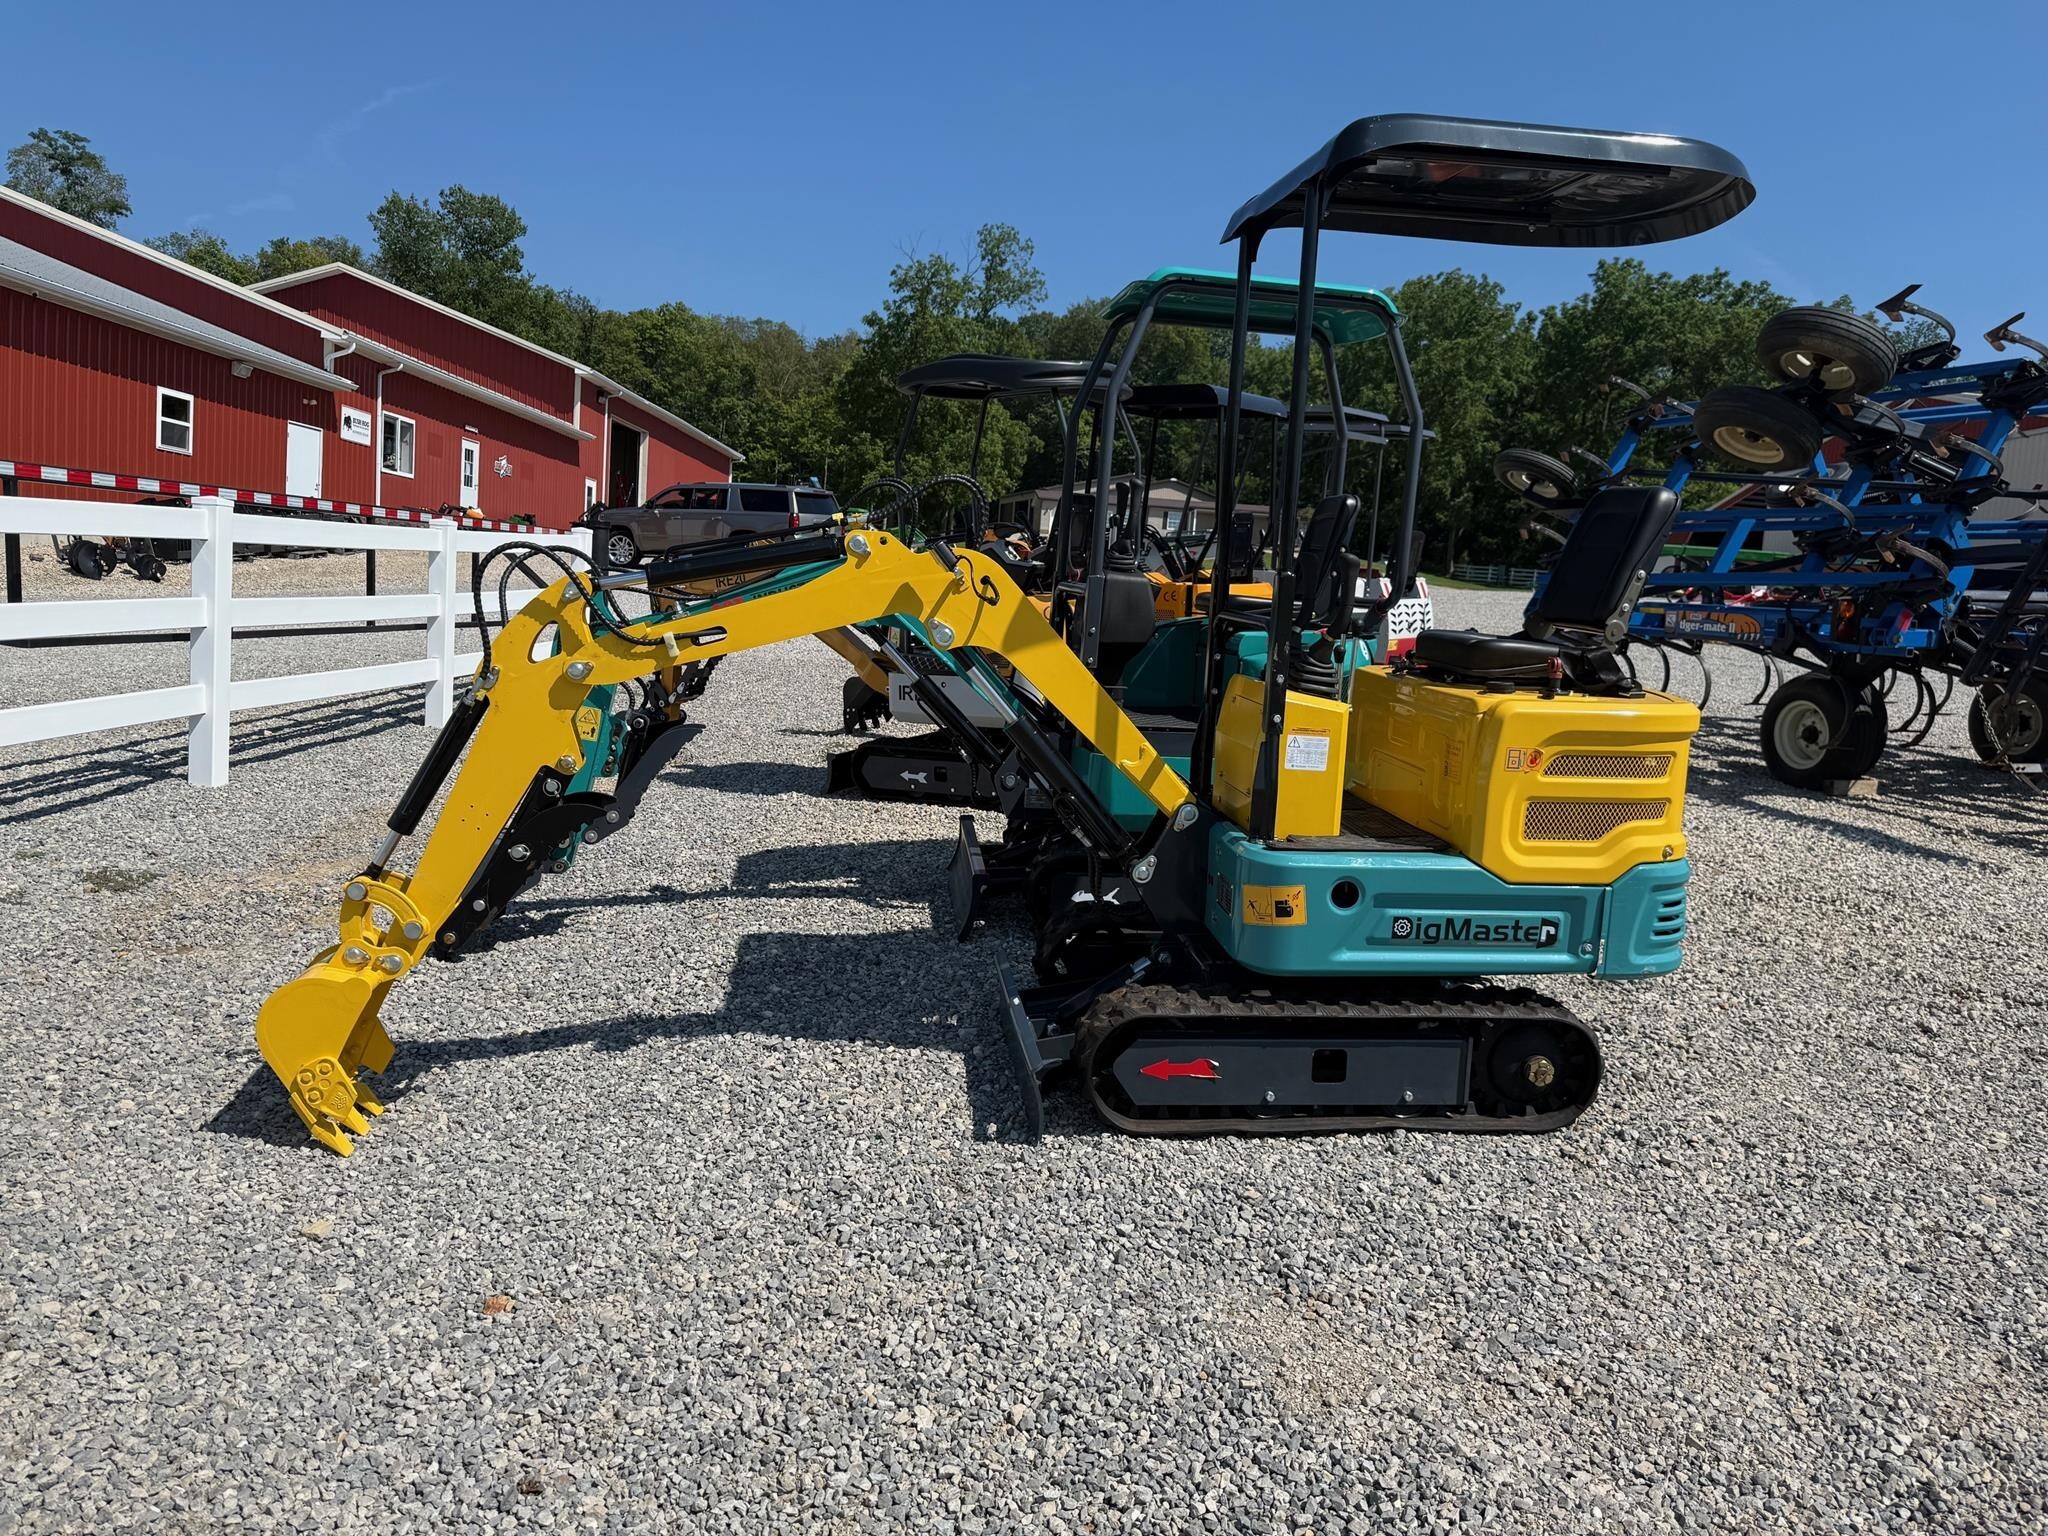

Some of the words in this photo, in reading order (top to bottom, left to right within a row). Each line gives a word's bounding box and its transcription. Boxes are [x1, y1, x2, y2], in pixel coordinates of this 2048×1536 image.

[715, 573, 746, 589] IRE20
[1164, 590, 1177, 602] CE
[1680, 619, 1727, 632] tiger-mate
[898, 684, 920, 701] IR
[1391, 916, 1560, 949] DigMaster
